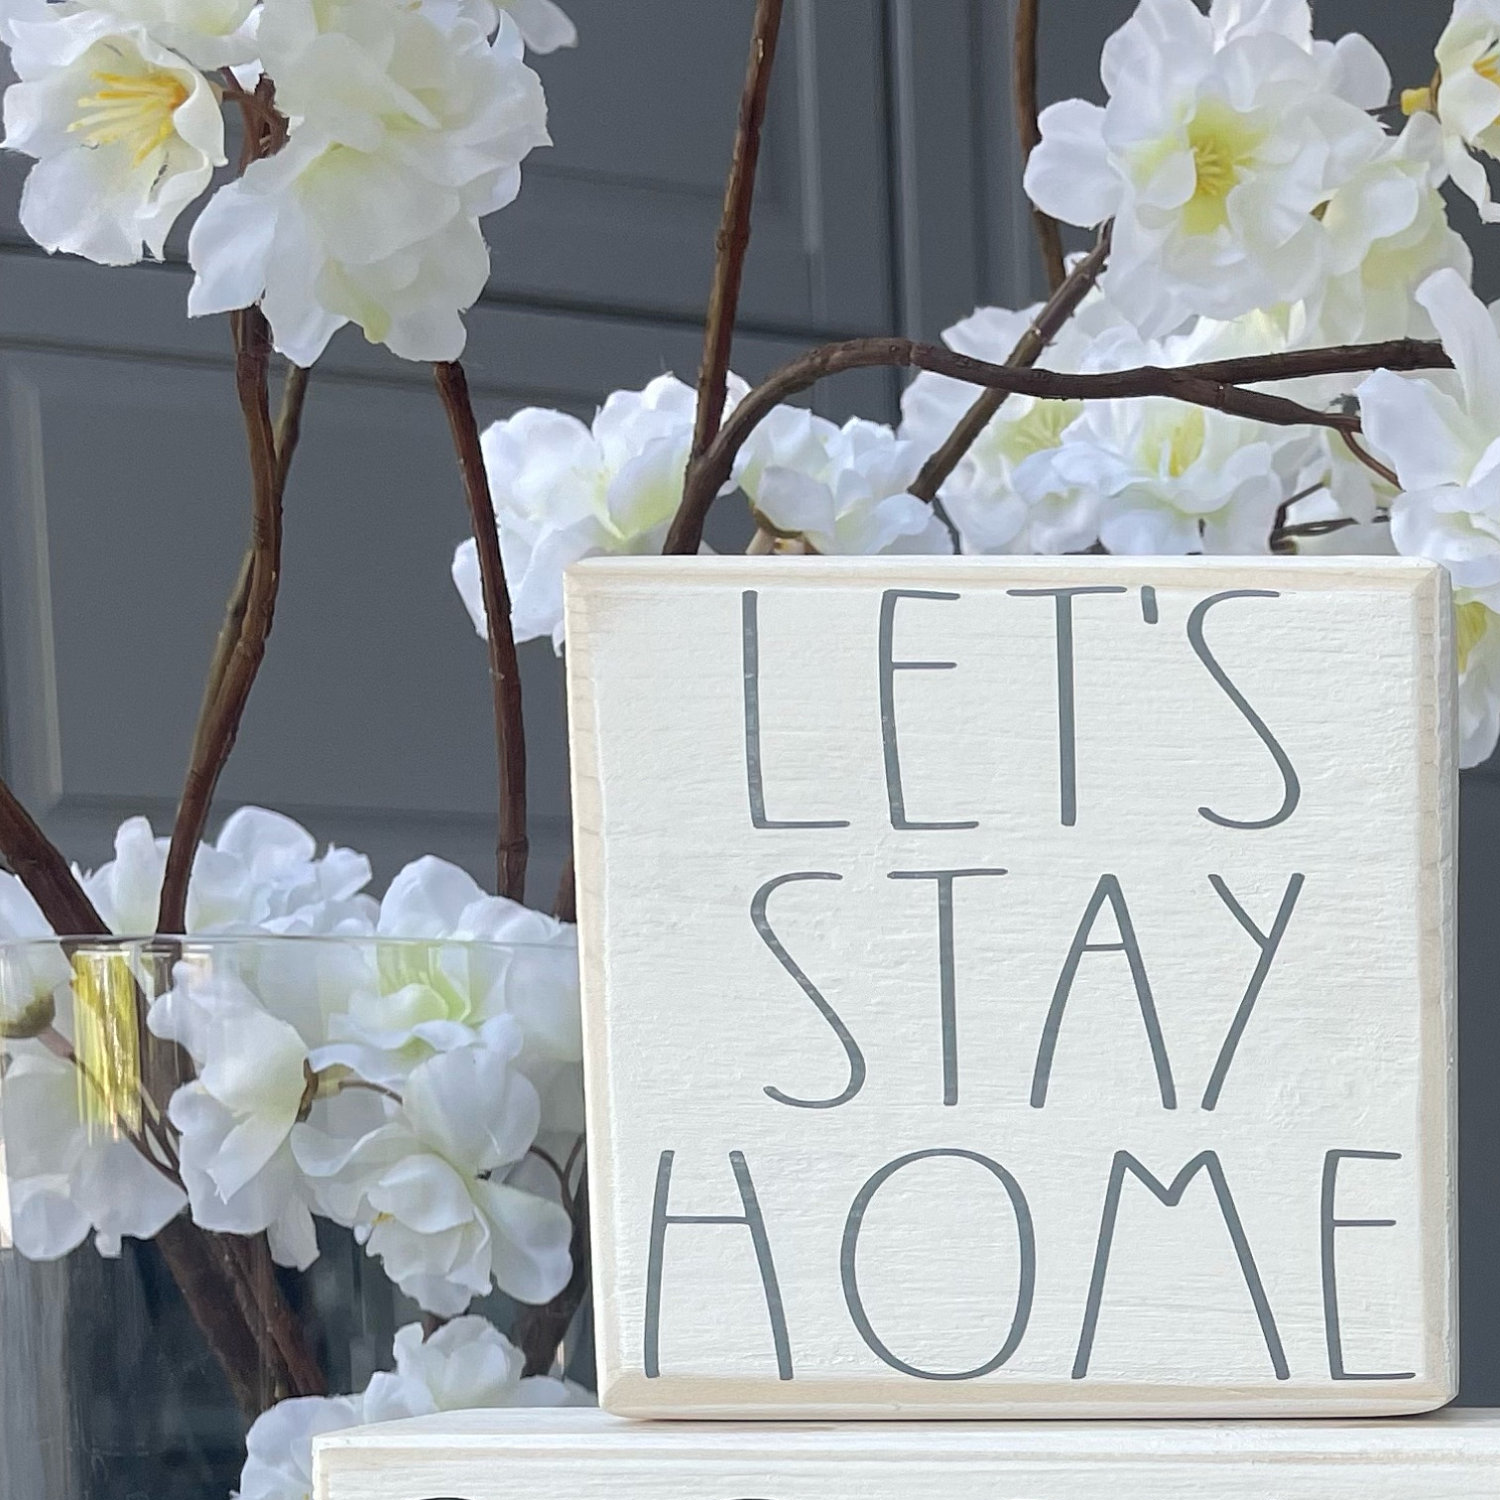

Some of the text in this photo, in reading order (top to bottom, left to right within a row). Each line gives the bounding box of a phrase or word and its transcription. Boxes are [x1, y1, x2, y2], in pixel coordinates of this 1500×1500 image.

[743, 586, 1301, 830] LET'S
[749, 869, 1307, 1110] STAY
[645, 1148, 1417, 1381] HOME
